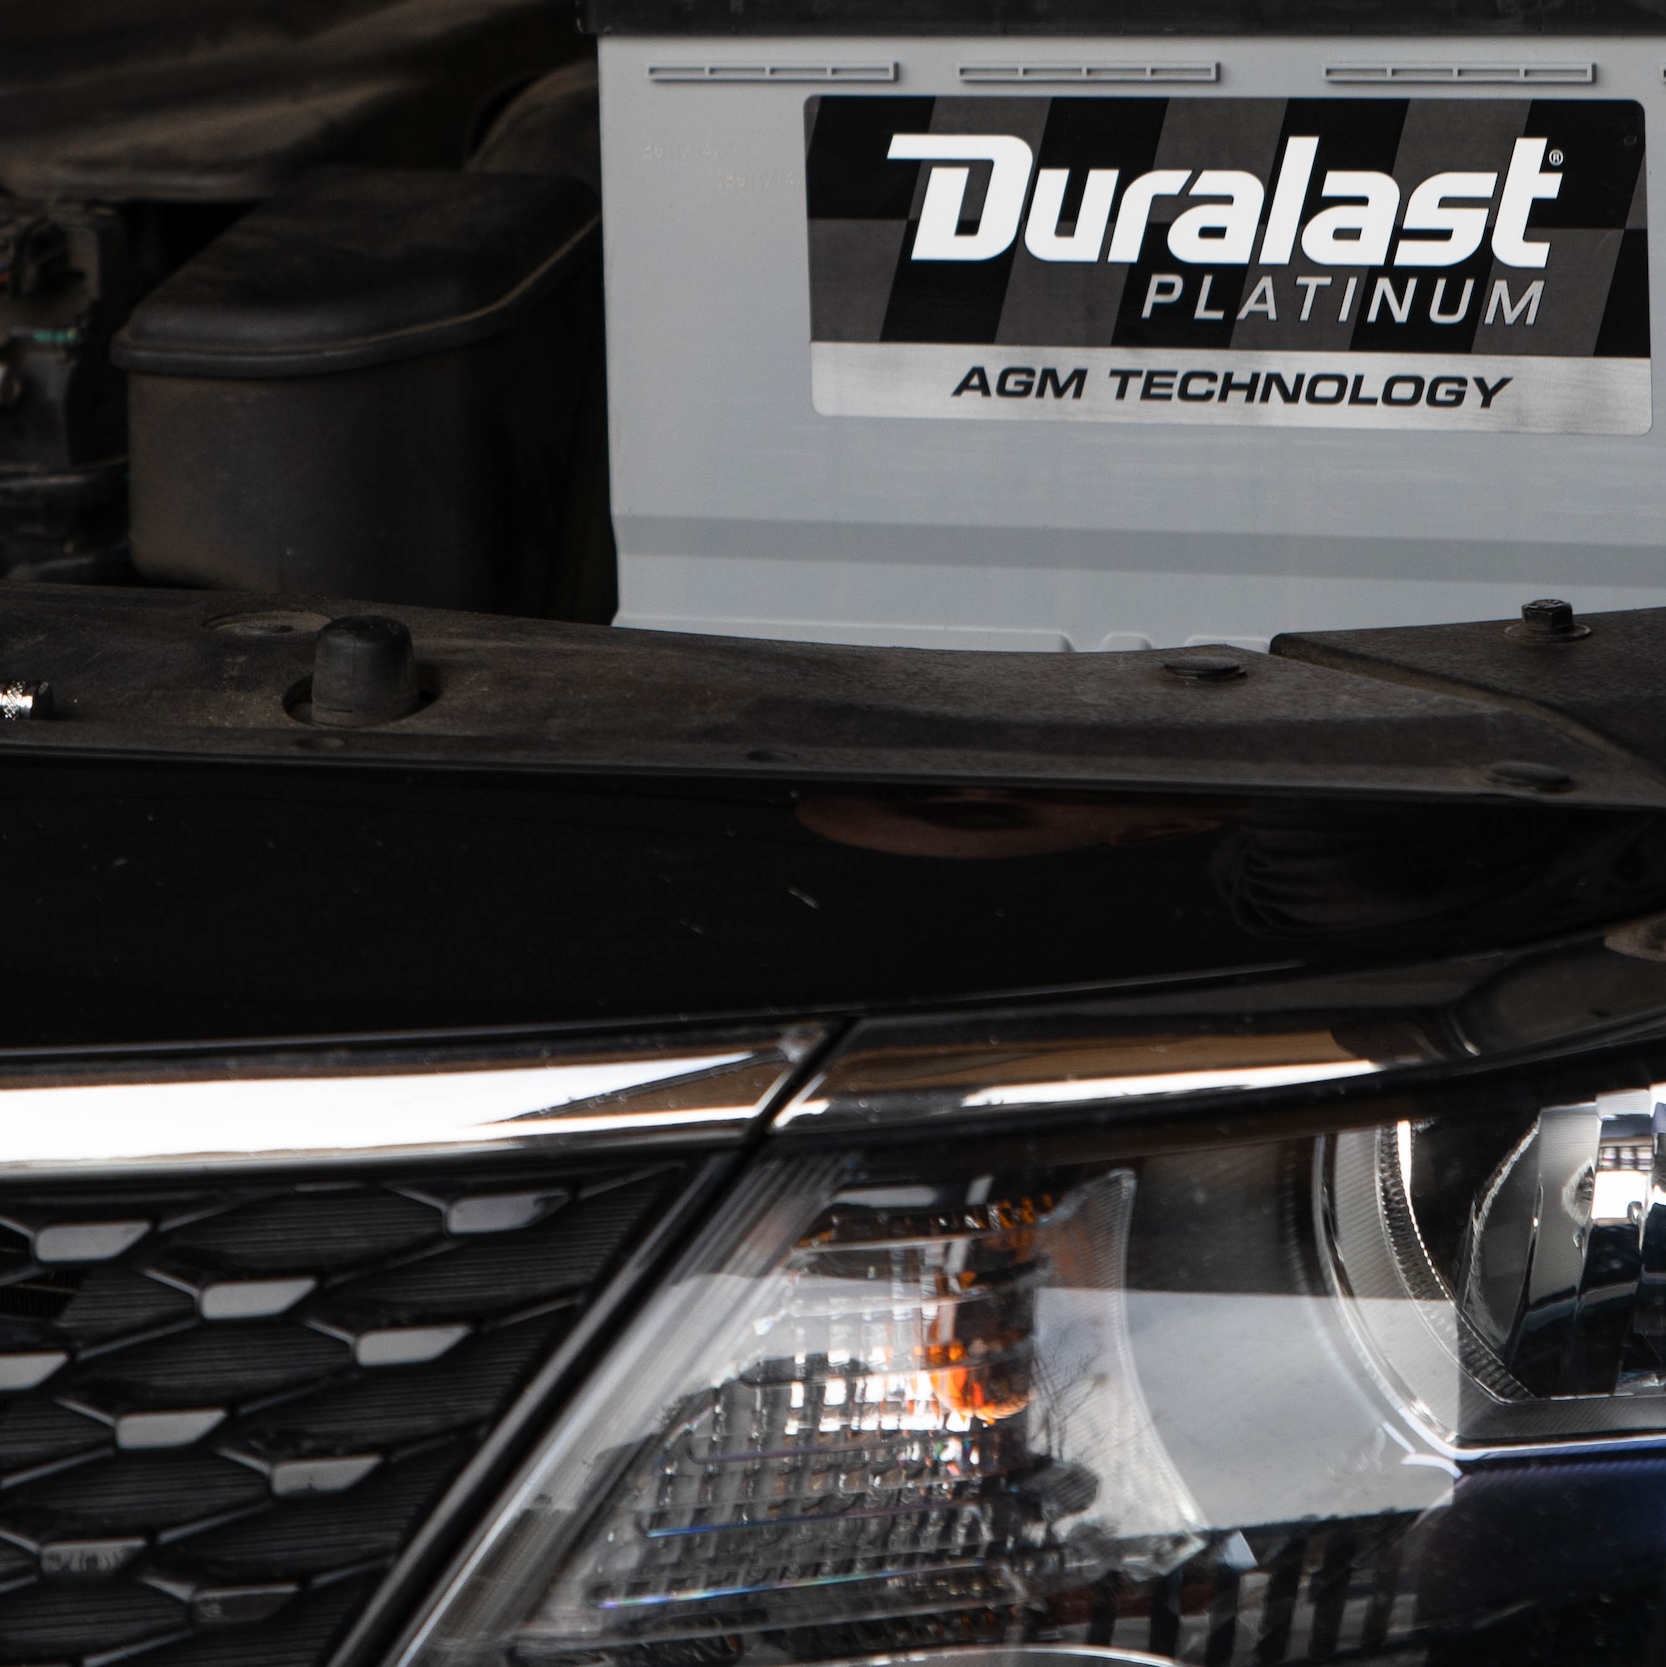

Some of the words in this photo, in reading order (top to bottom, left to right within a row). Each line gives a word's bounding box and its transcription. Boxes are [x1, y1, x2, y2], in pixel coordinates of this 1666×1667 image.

[886, 133, 1564, 269] Duralast
[1141, 273, 1545, 326] PLATINUM
[952, 366, 1088, 400] AGM
[1109, 368, 1513, 409] TECHNOLOGY
